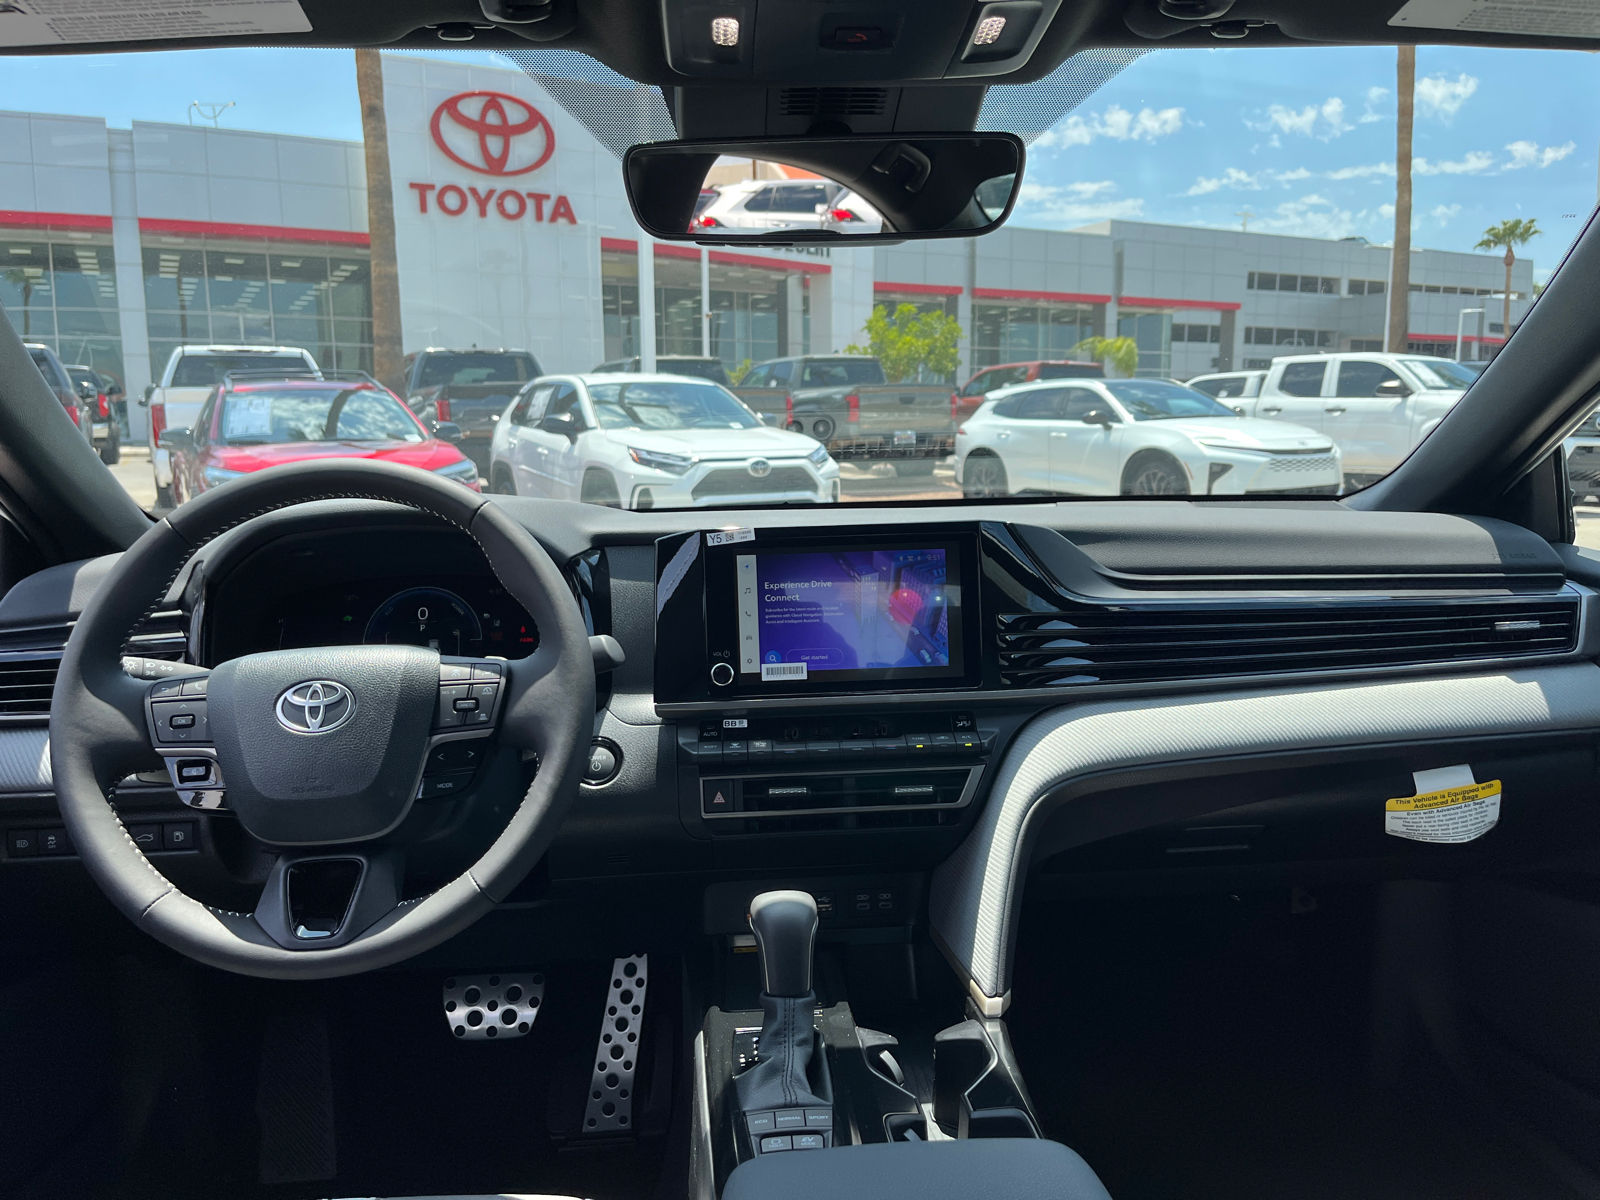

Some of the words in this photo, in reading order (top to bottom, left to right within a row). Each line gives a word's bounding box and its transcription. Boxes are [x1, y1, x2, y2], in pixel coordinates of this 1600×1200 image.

[409, 182, 577, 225] TOYOTA
[710, 534, 722, 544] Y5
[764, 581, 809, 590] Experience
[1413, 795, 1438, 803] Vehicle
[1448, 786, 1479, 798] Equipped
[1414, 799, 1448, 809] Advanced
[1436, 805, 1462, 813] Advanced
